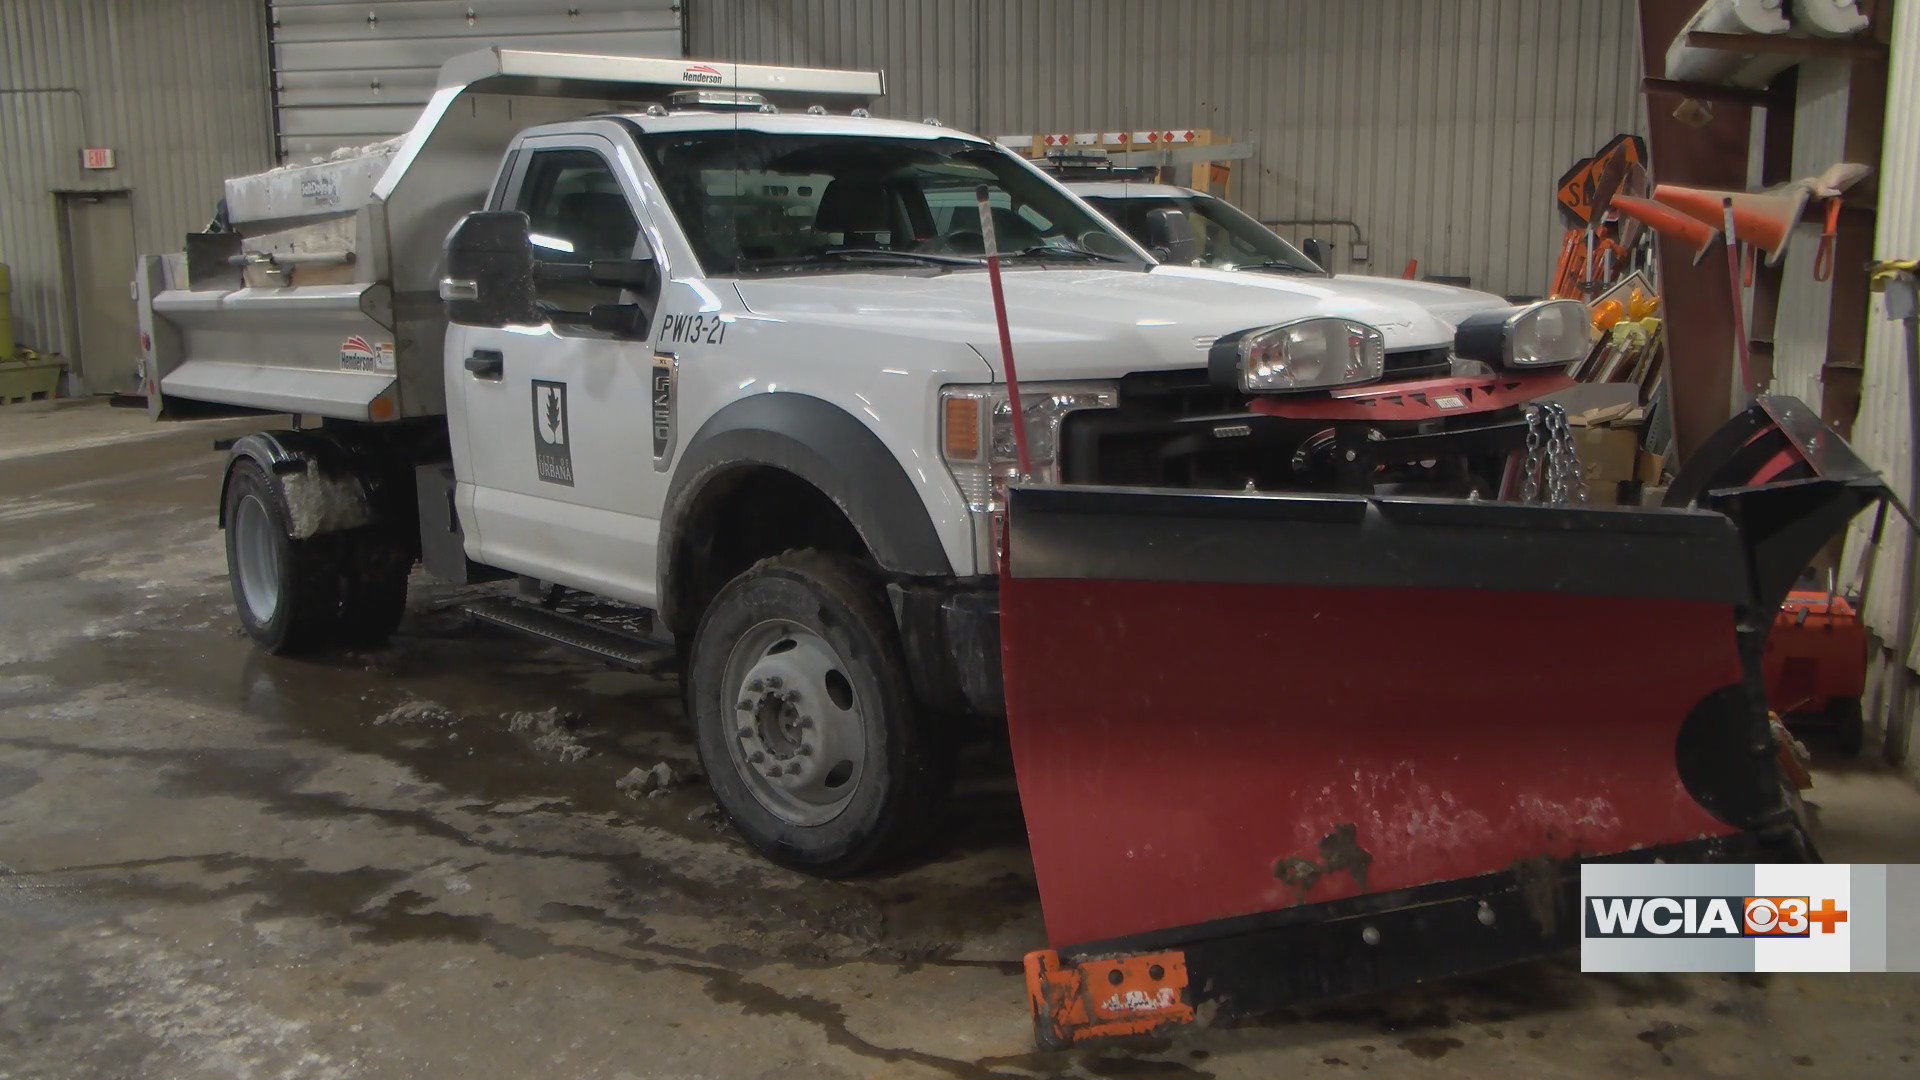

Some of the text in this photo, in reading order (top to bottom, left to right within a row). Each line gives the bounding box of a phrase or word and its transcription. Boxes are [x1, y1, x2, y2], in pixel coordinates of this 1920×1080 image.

[683, 72, 722, 84] Henderson
[88, 150, 106, 166] EXIT
[660, 314, 727, 345] PW13-21
[341, 351, 373, 371] Henderson
[538, 454, 569, 467] CITY OF
[539, 462, 573, 481] URBANA
